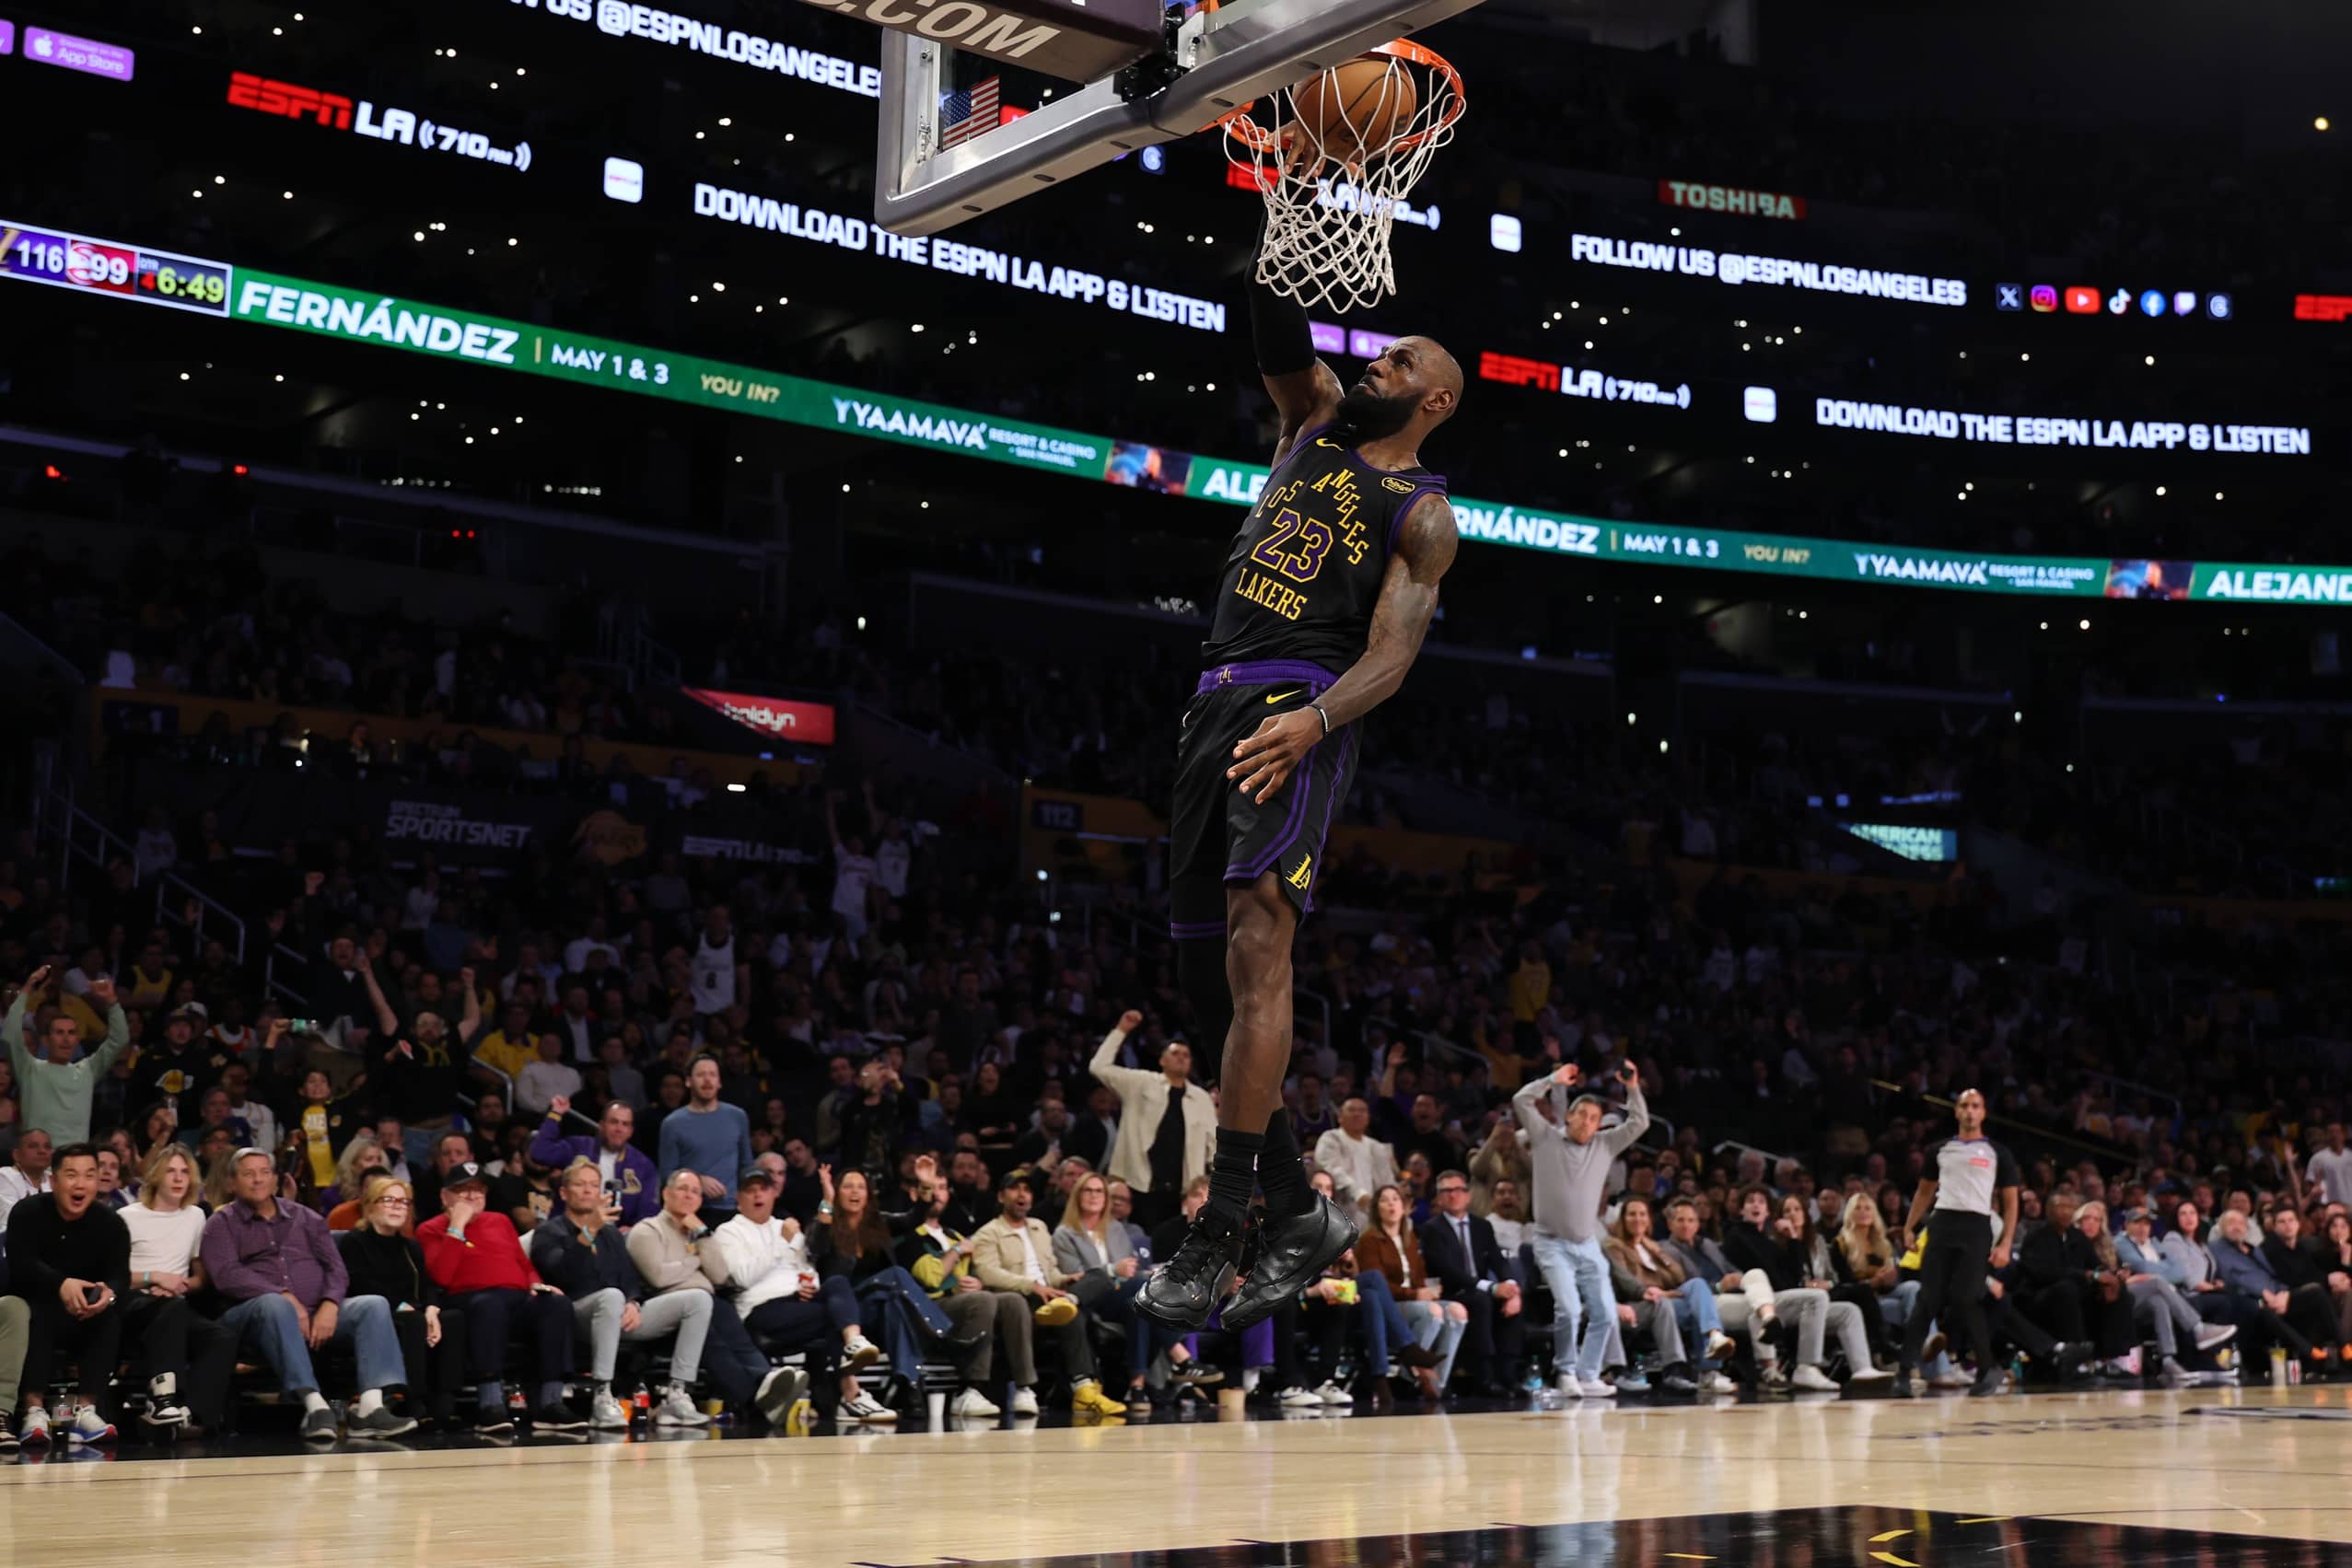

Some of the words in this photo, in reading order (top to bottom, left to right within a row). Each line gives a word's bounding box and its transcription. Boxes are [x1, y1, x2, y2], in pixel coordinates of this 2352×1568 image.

[596, 0, 880, 98] @ESPNLOSANGELE
[798, 0, 1061, 58] .COM
[57, 48, 87, 66] App
[227, 72, 353, 130] ESPN
[355, 101, 416, 145] LA
[1668, 180, 1796, 219] TOSHIBA
[17, 238, 64, 274] 116
[89, 252, 129, 286] 99
[694, 182, 867, 250] DOWNLOAD
[870, 224, 928, 265] THE
[932, 238, 1007, 284] ESPN
[1010, 255, 1048, 294] LA
[1048, 263, 1105, 304] APP
[1108, 280, 1129, 310] &
[1131, 285, 1226, 332] LISTEN
[1571, 234, 1677, 273] FOLLOW
[1678, 247, 1716, 277] US
[1717, 253, 1967, 306] @ESPNLOSANGELES
[157, 267, 226, 304] 6:49
[238, 279, 519, 365] FERNÁNDEZ
[551, 342, 607, 373] MAY
[611, 355, 623, 377] 1
[628, 357, 647, 381] &
[653, 363, 670, 385] 3
[700, 374, 742, 397] YOU
[747, 383, 781, 404] IN?
[1479, 351, 1560, 391] ESPN
[1560, 366, 1604, 399] LA
[1816, 398, 1960, 438] DOWNLOAD
[1960, 413, 2013, 443] THE
[2016, 417, 2090, 446] ESPN
[2092, 420, 2130, 447] LA
[2129, 422, 2186, 449] APP
[2187, 424, 2211, 451] &
[2212, 424, 2311, 455] LISTEN
[1254, 479, 1304, 518] LOS
[1310, 468, 1370, 566] ANGELES
[1250, 506, 1335, 584] 23
[1624, 531, 1668, 554] MAY
[1671, 536, 1682, 556] 1
[1684, 537, 1702, 557] &
[1706, 540, 1720, 559] 3
[1743, 544, 1778, 563] YOU
[1234, 567, 1309, 621] LAKERS
[384, 814, 533, 849] SPORTSNET
[1038, 804, 1077, 829] 112
